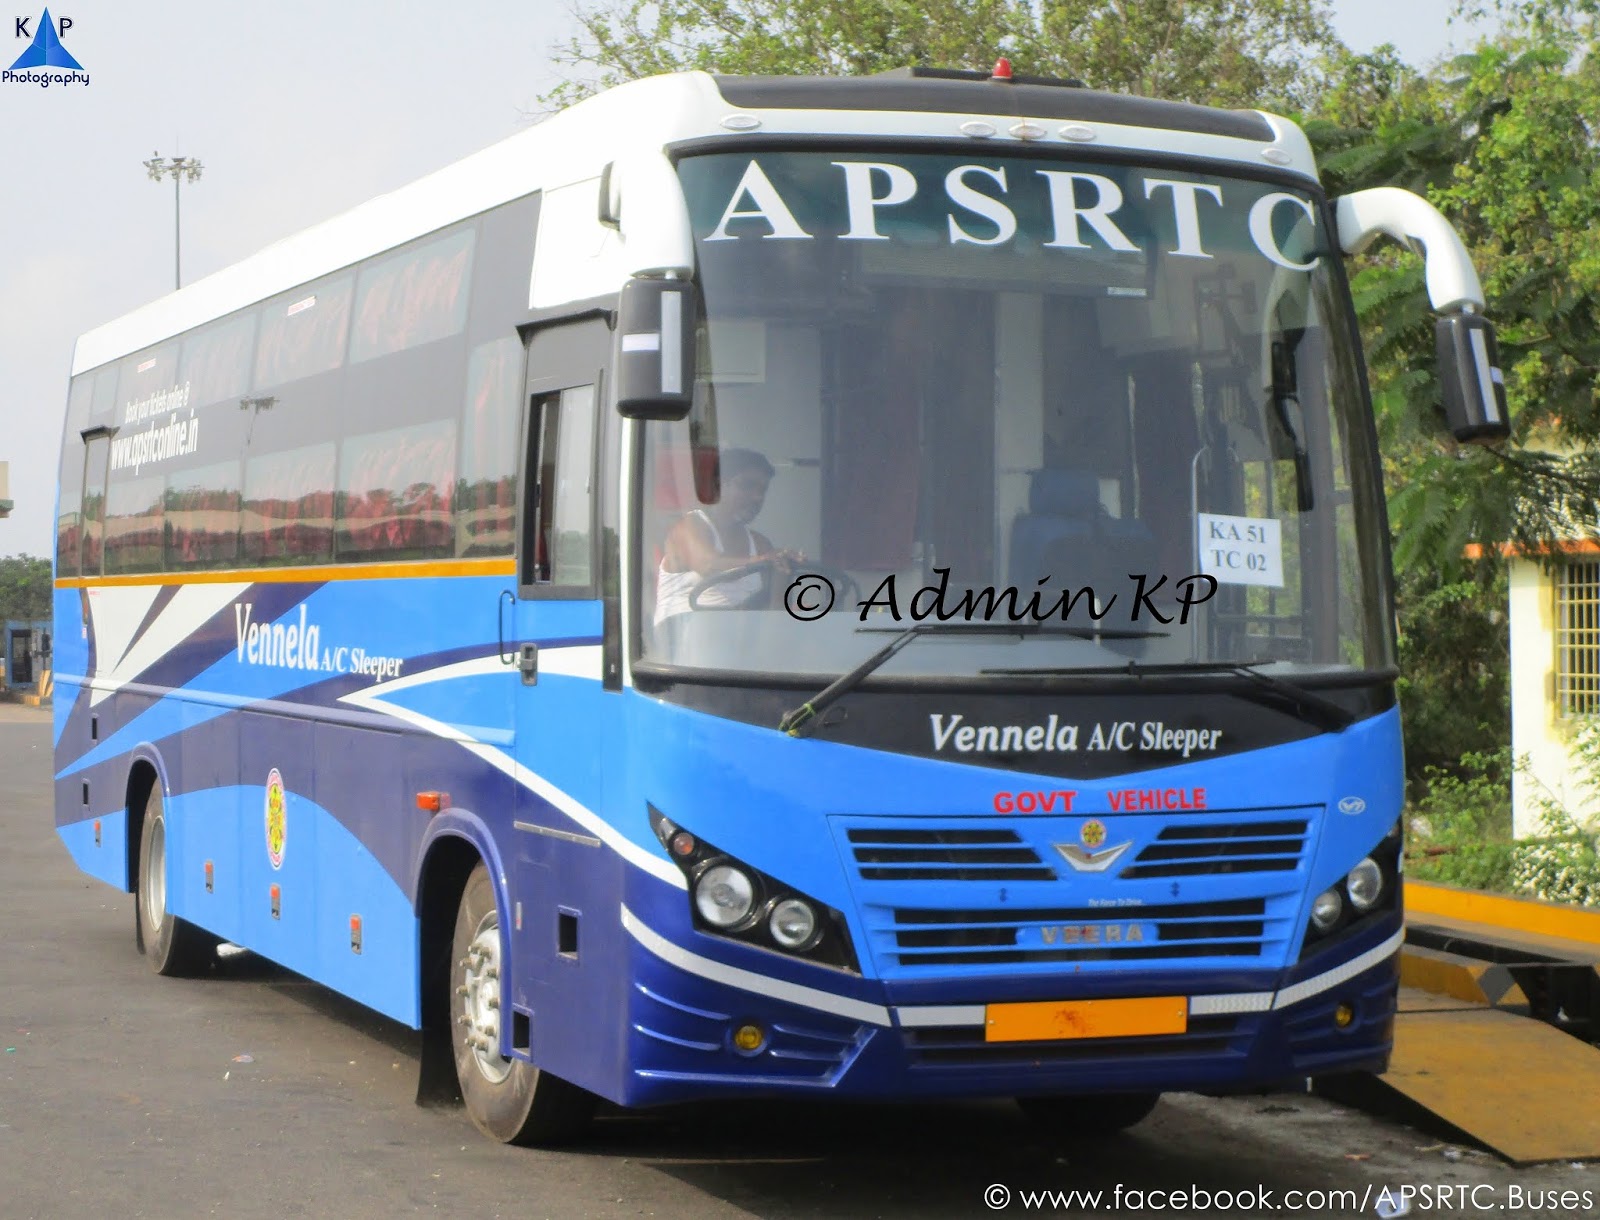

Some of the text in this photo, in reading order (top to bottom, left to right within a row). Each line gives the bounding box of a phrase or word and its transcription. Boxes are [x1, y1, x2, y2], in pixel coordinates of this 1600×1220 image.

[702, 158, 1322, 273] APSRTC
[111, 407, 199, 476] www.apsrtconline.in
[1210, 521, 1266, 544] KA 51
[1210, 549, 1267, 571] TC 02
[235, 603, 404, 683] Vennela A/C Sleeper
[930, 713, 1223, 758] Vennela A/C Sleeper
[994, 787, 1208, 814] GOVT VEHICLE
[1041, 923, 1144, 945] VEERA
